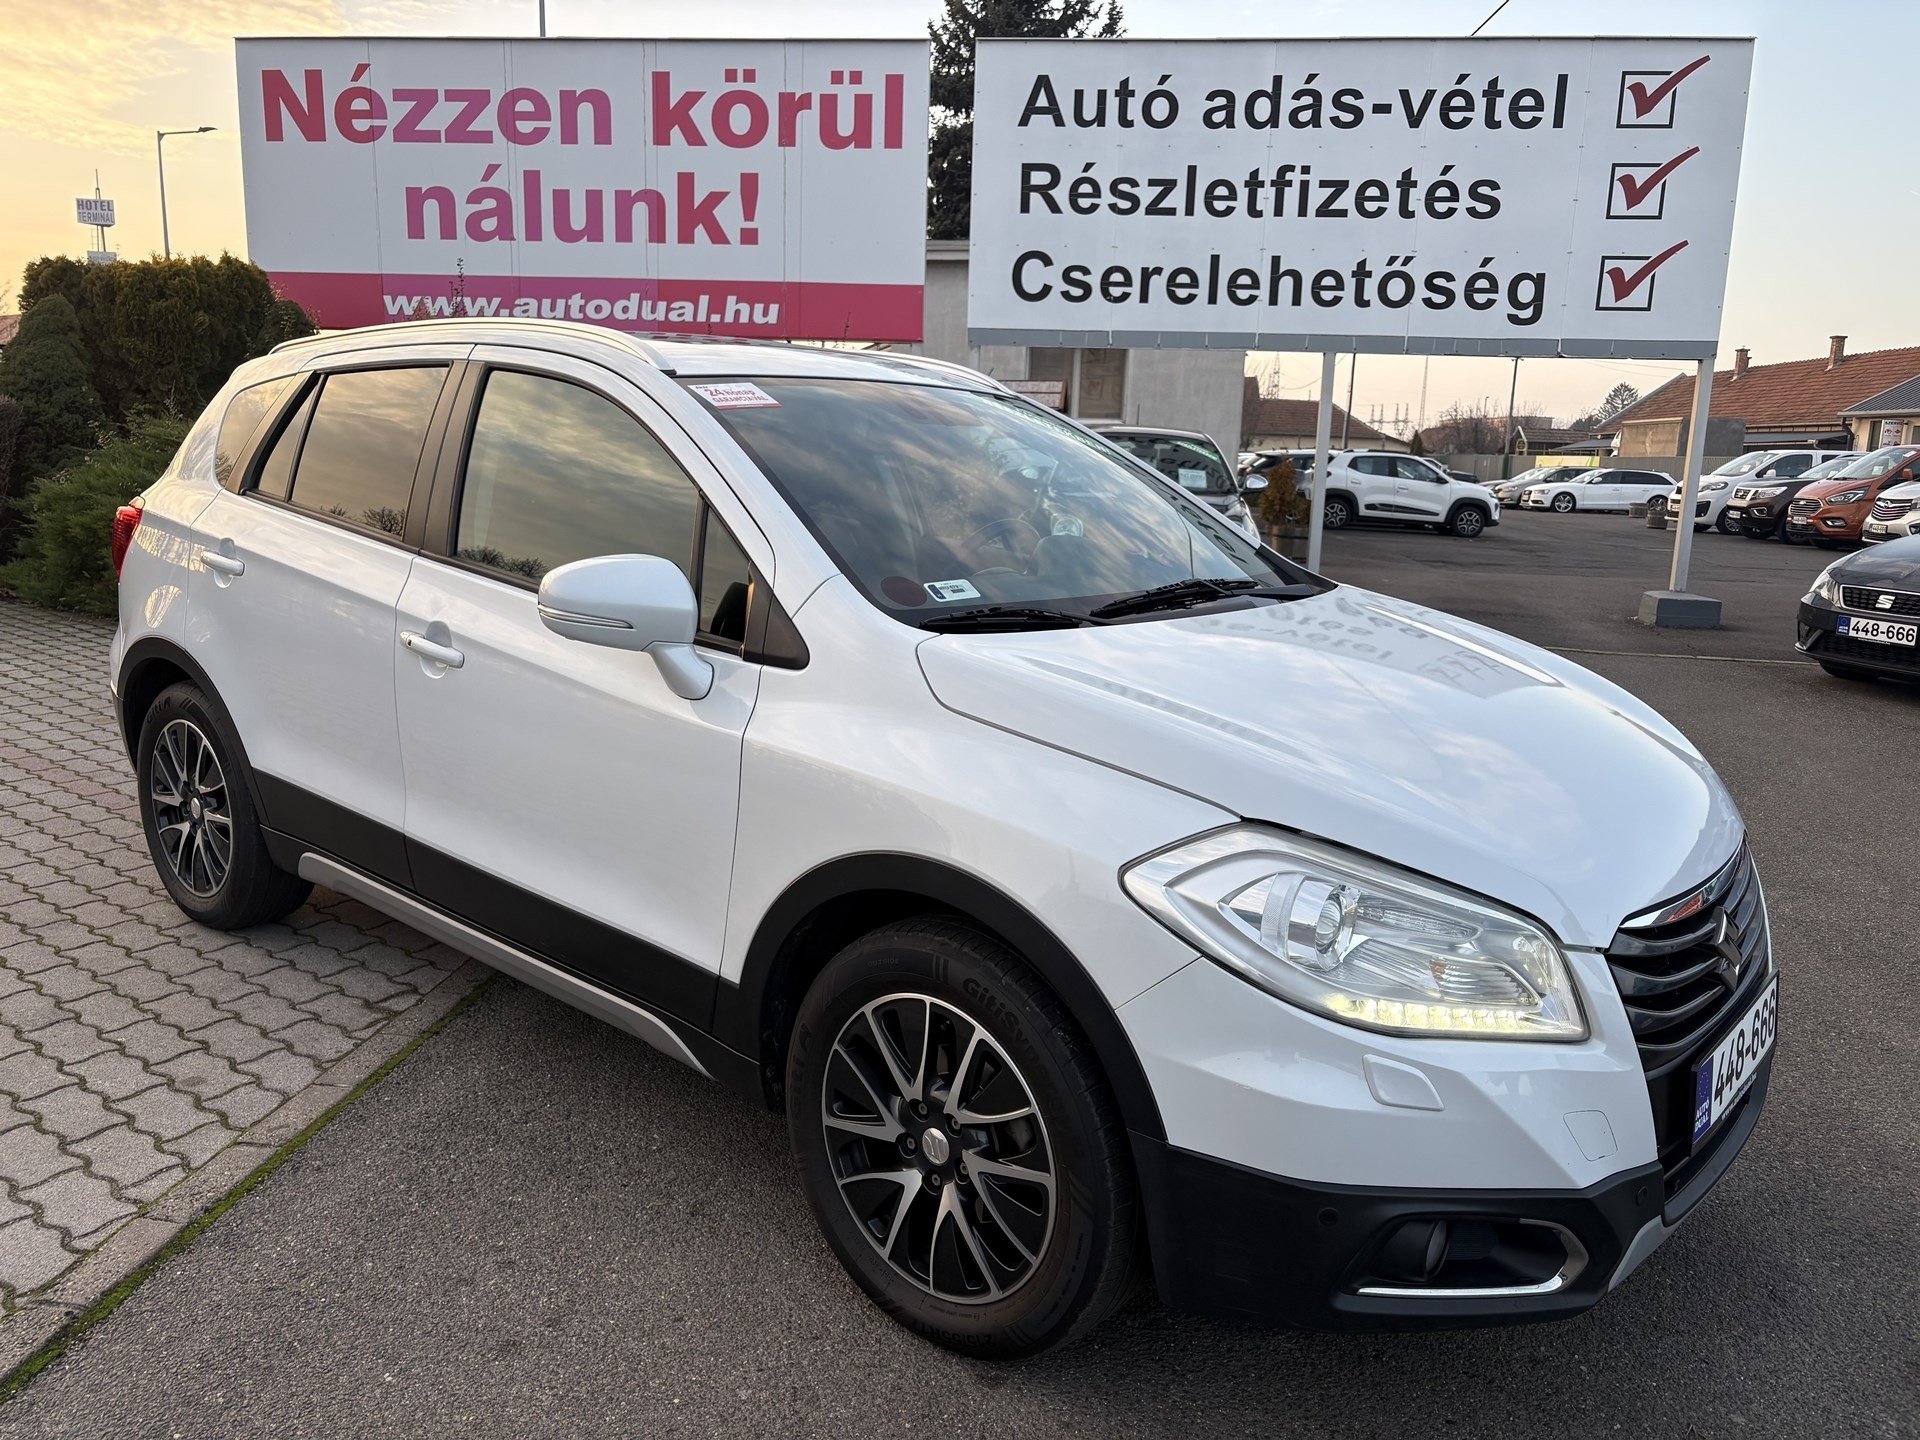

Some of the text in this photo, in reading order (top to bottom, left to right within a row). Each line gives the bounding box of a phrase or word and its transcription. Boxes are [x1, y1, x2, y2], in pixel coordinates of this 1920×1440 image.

[260, 62, 905, 150] Nézzen körül
[1017, 71, 1569, 131] Autó adás-vétel
[76, 200, 114, 212] HOTEL
[403, 162, 761, 246] nálunk!
[1018, 161, 1503, 221] Részletfizetés
[383, 291, 780, 326] www.autodual.hu
[1010, 249, 1548, 326] Cserelehetőség
[1851, 620, 1916, 643] 448-666
[1713, 988, 1776, 1107] 448-666
